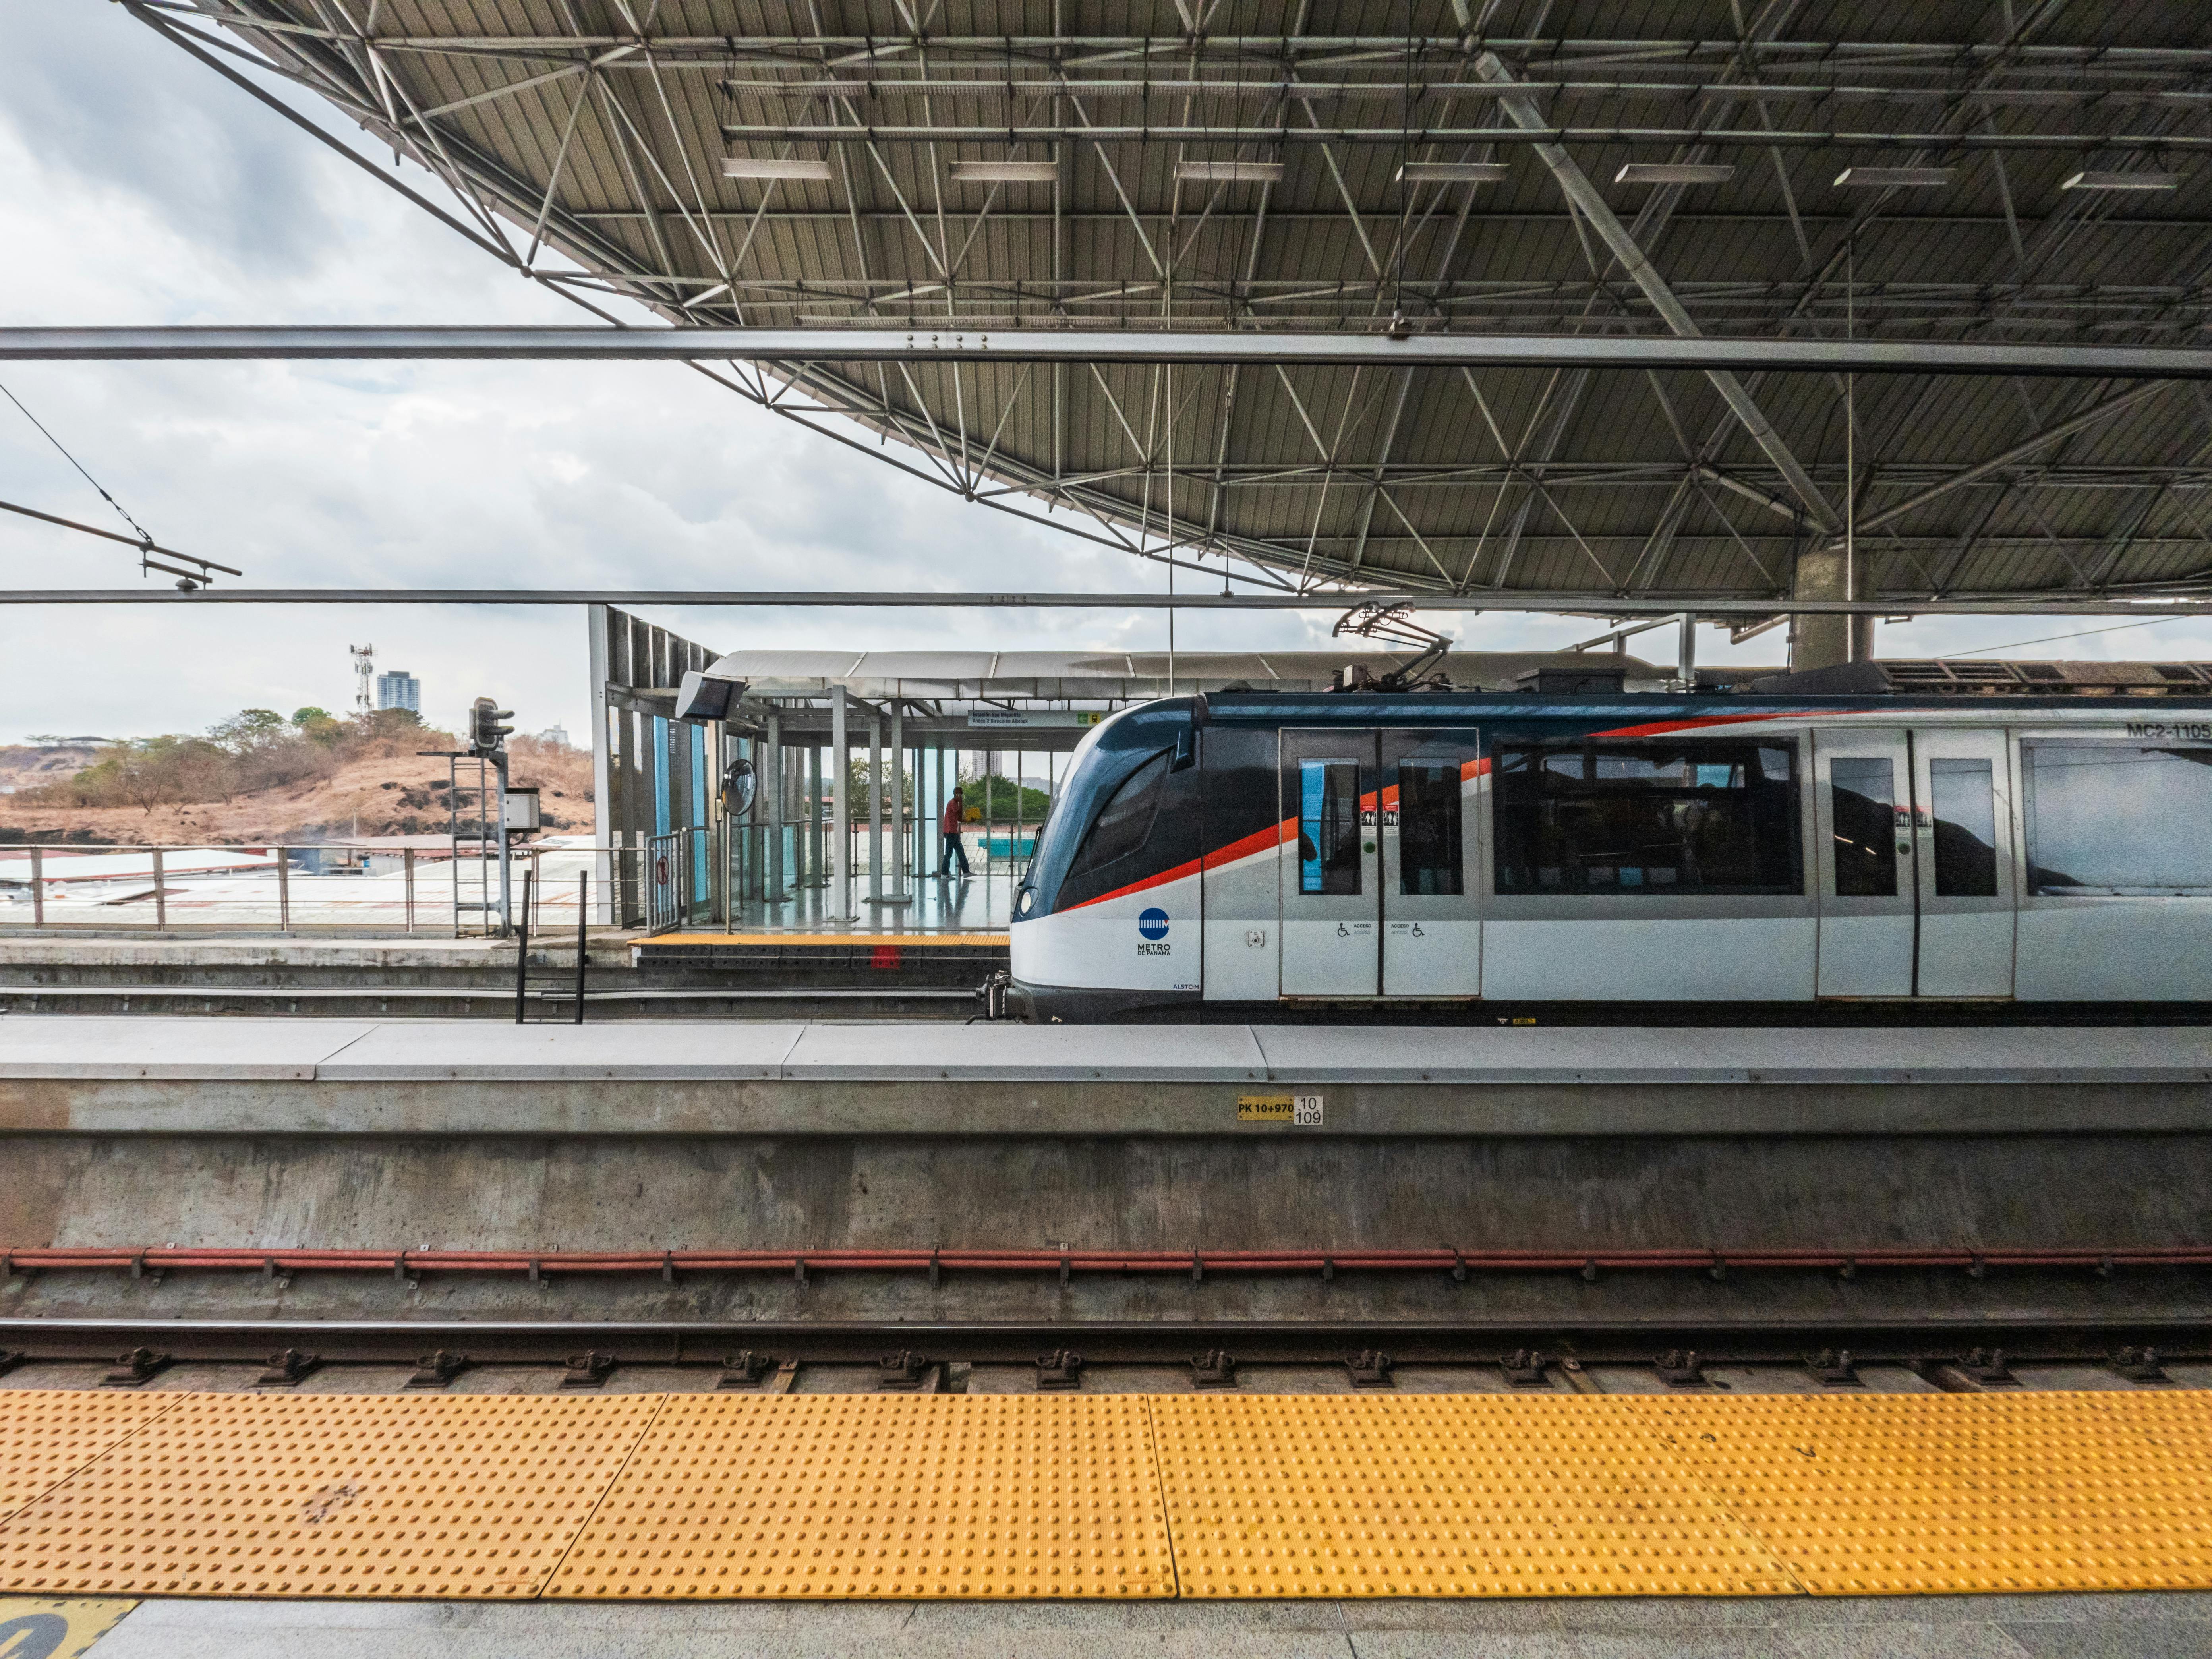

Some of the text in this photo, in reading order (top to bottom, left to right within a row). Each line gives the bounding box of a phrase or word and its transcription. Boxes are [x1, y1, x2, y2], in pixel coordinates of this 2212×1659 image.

[1238, 1104, 1294, 1113] PK 10+970
[1301, 1097, 1317, 1110] 10
[1296, 1112, 1321, 1124] 109
